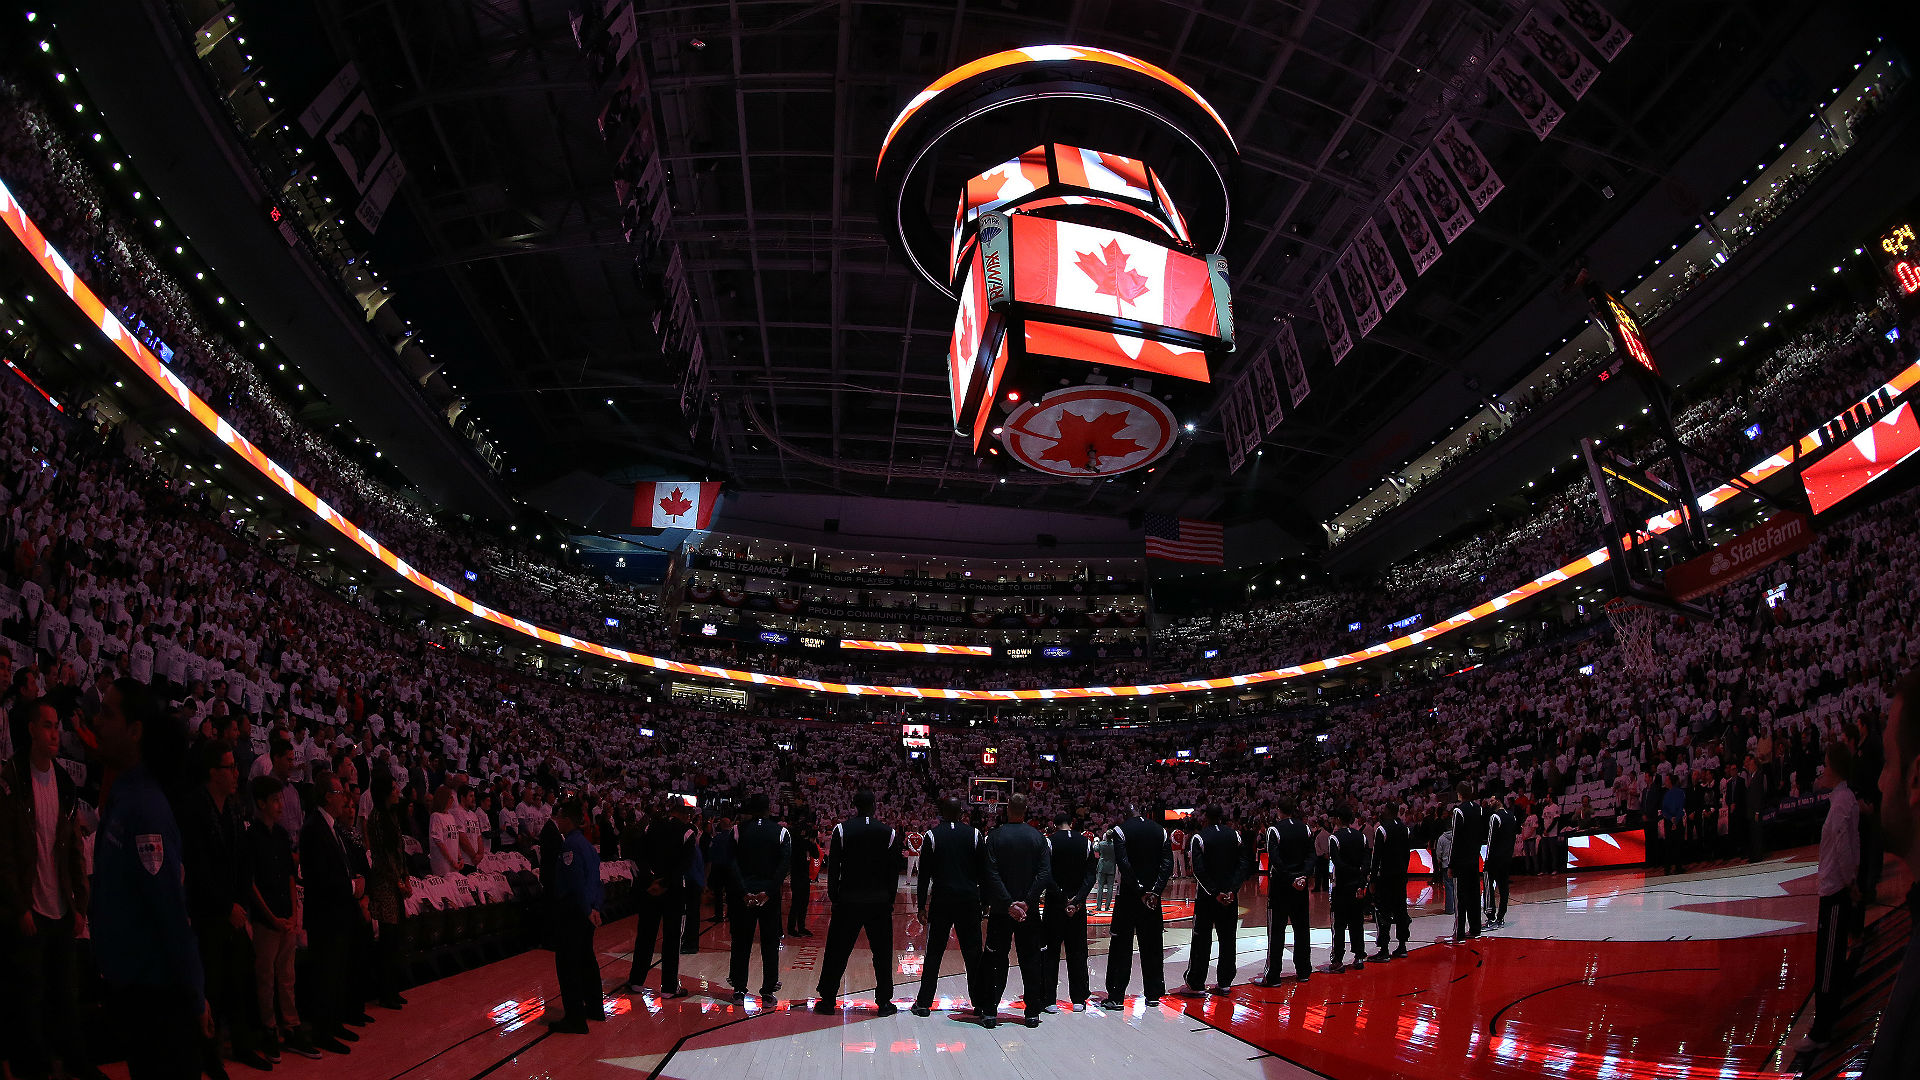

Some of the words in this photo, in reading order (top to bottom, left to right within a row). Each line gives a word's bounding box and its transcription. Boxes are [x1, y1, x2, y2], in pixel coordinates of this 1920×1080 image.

[1603, 29, 1625, 56] 1967
[1570, 67, 1594, 93] 1964
[1536, 107, 1559, 133] 1963
[1476, 181, 1498, 206] 1962
[1446, 214, 1469, 237] 1951
[1416, 246, 1436, 270] 1949
[985, 250, 1004, 302] RE/MAX
[1384, 282, 1402, 306] 1948
[1360, 309, 1377, 332] 1947
[709, 559, 736, 571] MLSE
[810, 572, 832, 580] WITH
[834, 575, 852, 583] OUR
[856, 576, 896, 586] PLAYERS
[936, 581, 957, 589] KIDS
[969, 583, 1004, 591] CHANCE
[808, 606, 844, 617] PROUD
[847, 610, 911, 621] COMMUNITY
[913, 614, 963, 623] PARTNER
[800, 637, 825, 646] CROWN
[1006, 648, 1032, 656] CROWN
